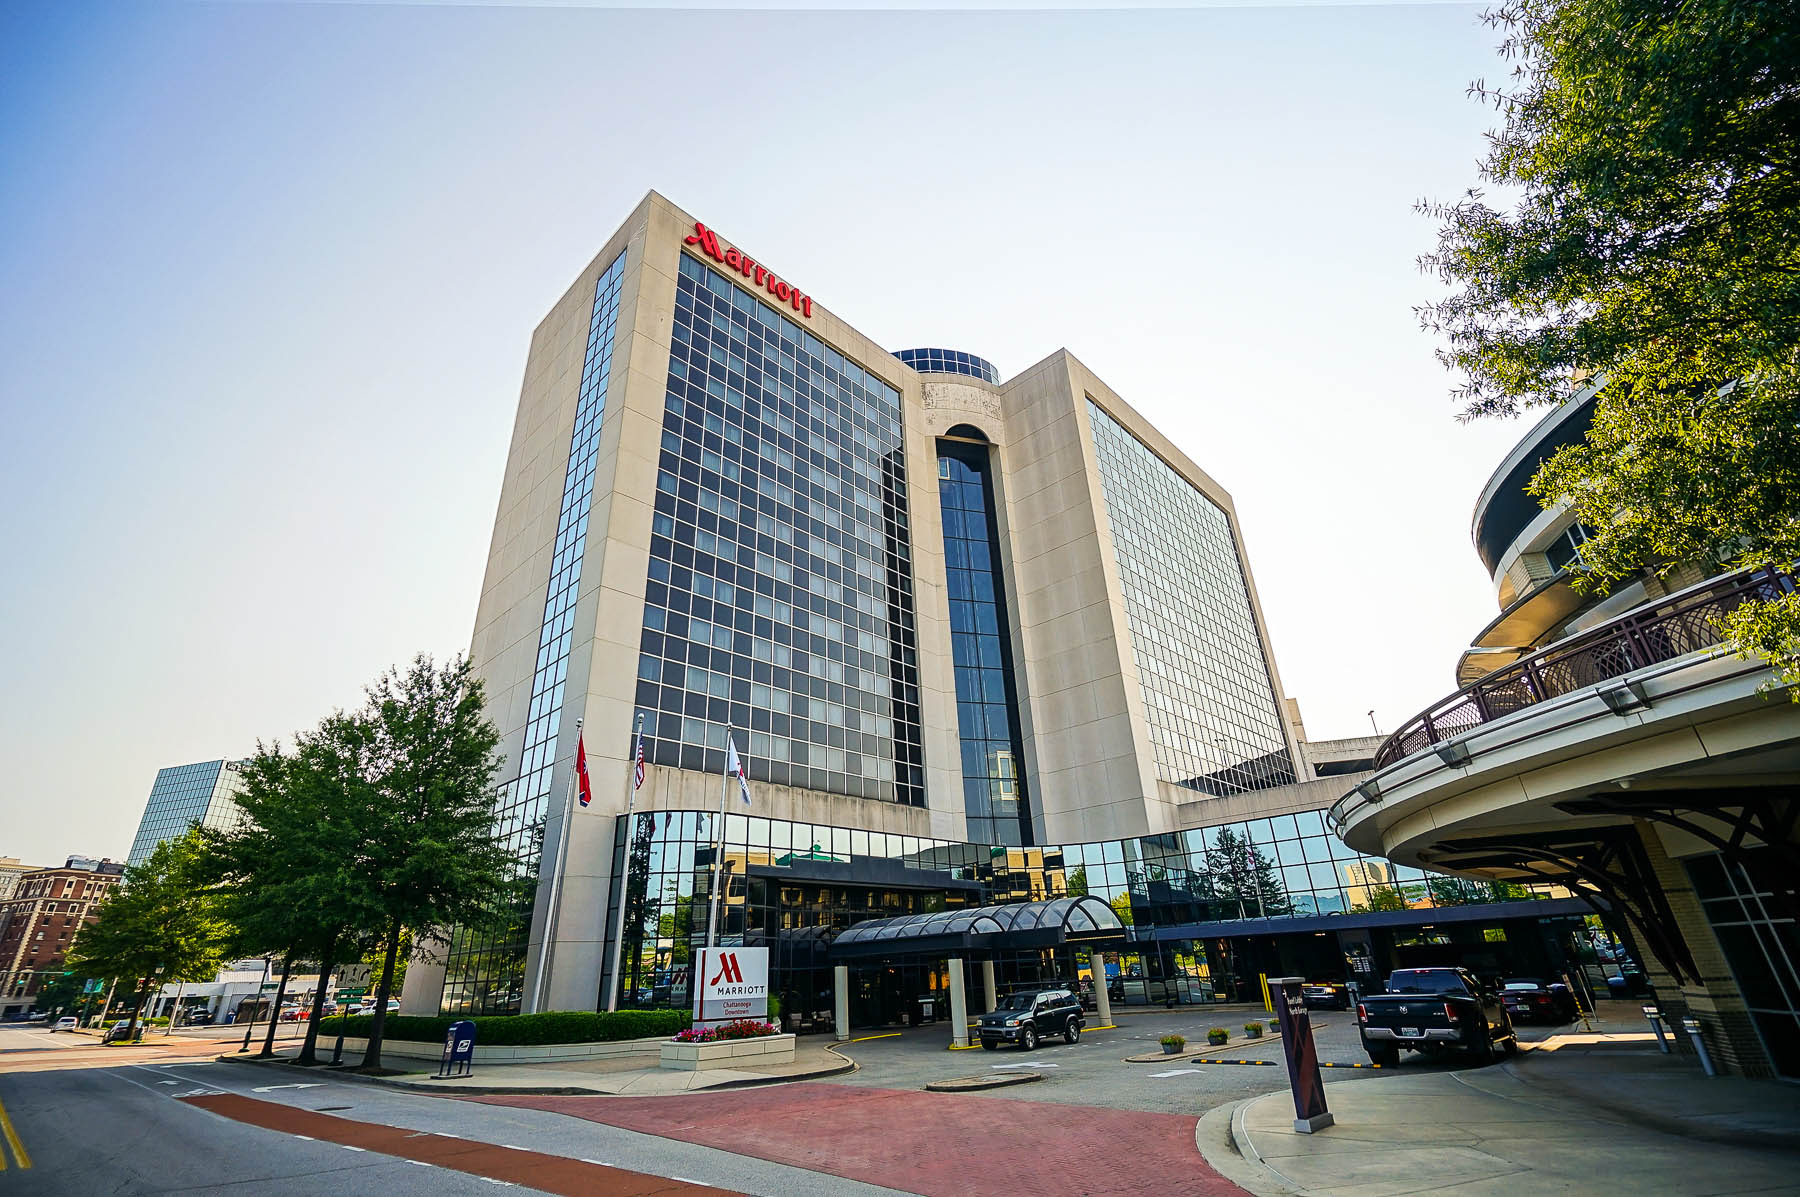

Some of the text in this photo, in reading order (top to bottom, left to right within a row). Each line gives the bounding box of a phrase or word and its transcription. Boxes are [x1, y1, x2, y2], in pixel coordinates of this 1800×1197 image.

[684, 222, 813, 319] Marriott
[717, 986, 765, 996] MARRIOTT
[722, 1001, 752, 1009] Chattanooga
